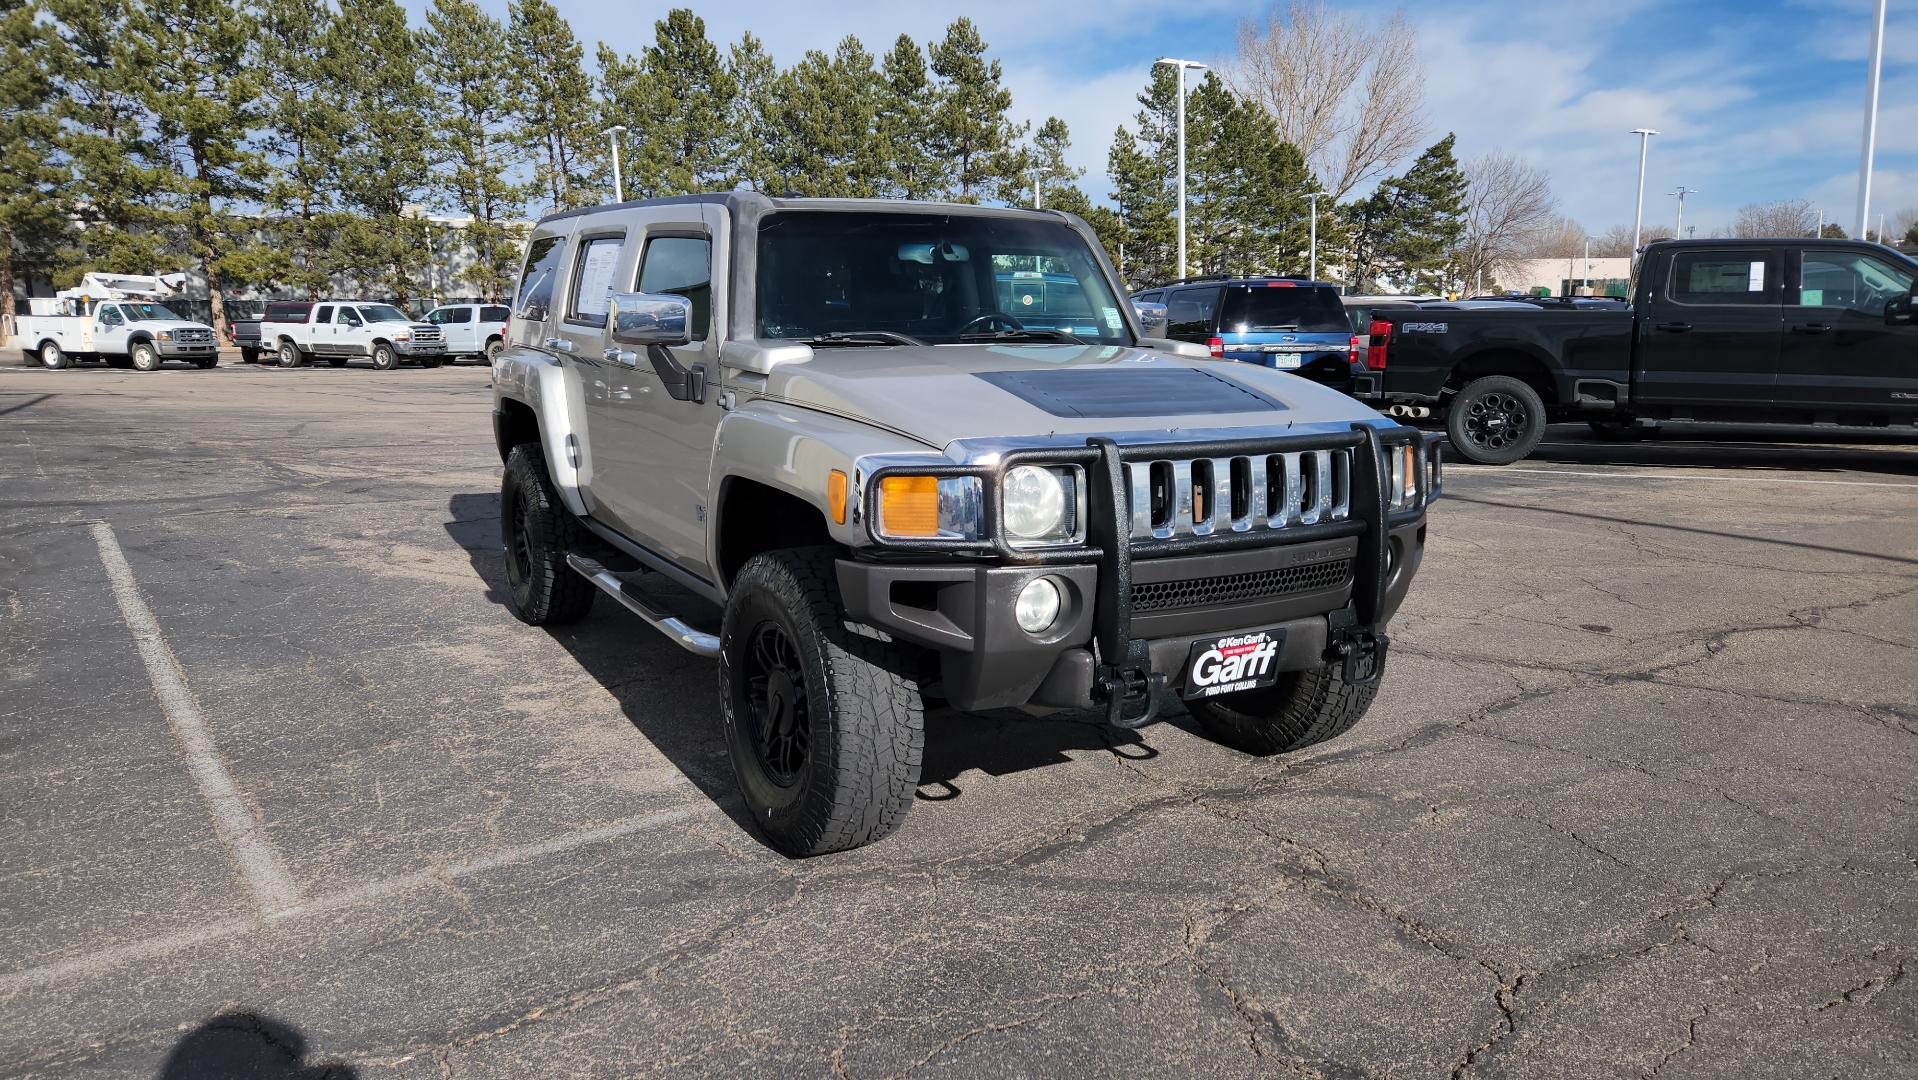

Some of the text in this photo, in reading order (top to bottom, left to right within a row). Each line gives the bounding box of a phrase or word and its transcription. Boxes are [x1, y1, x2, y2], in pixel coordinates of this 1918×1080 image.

[1402, 322, 1448, 333] FX4
[1226, 633, 1265, 647] Ken Garff
[1193, 641, 1277, 686] Garff
[1205, 680, 1256, 696] FORD FORT COLLINS
